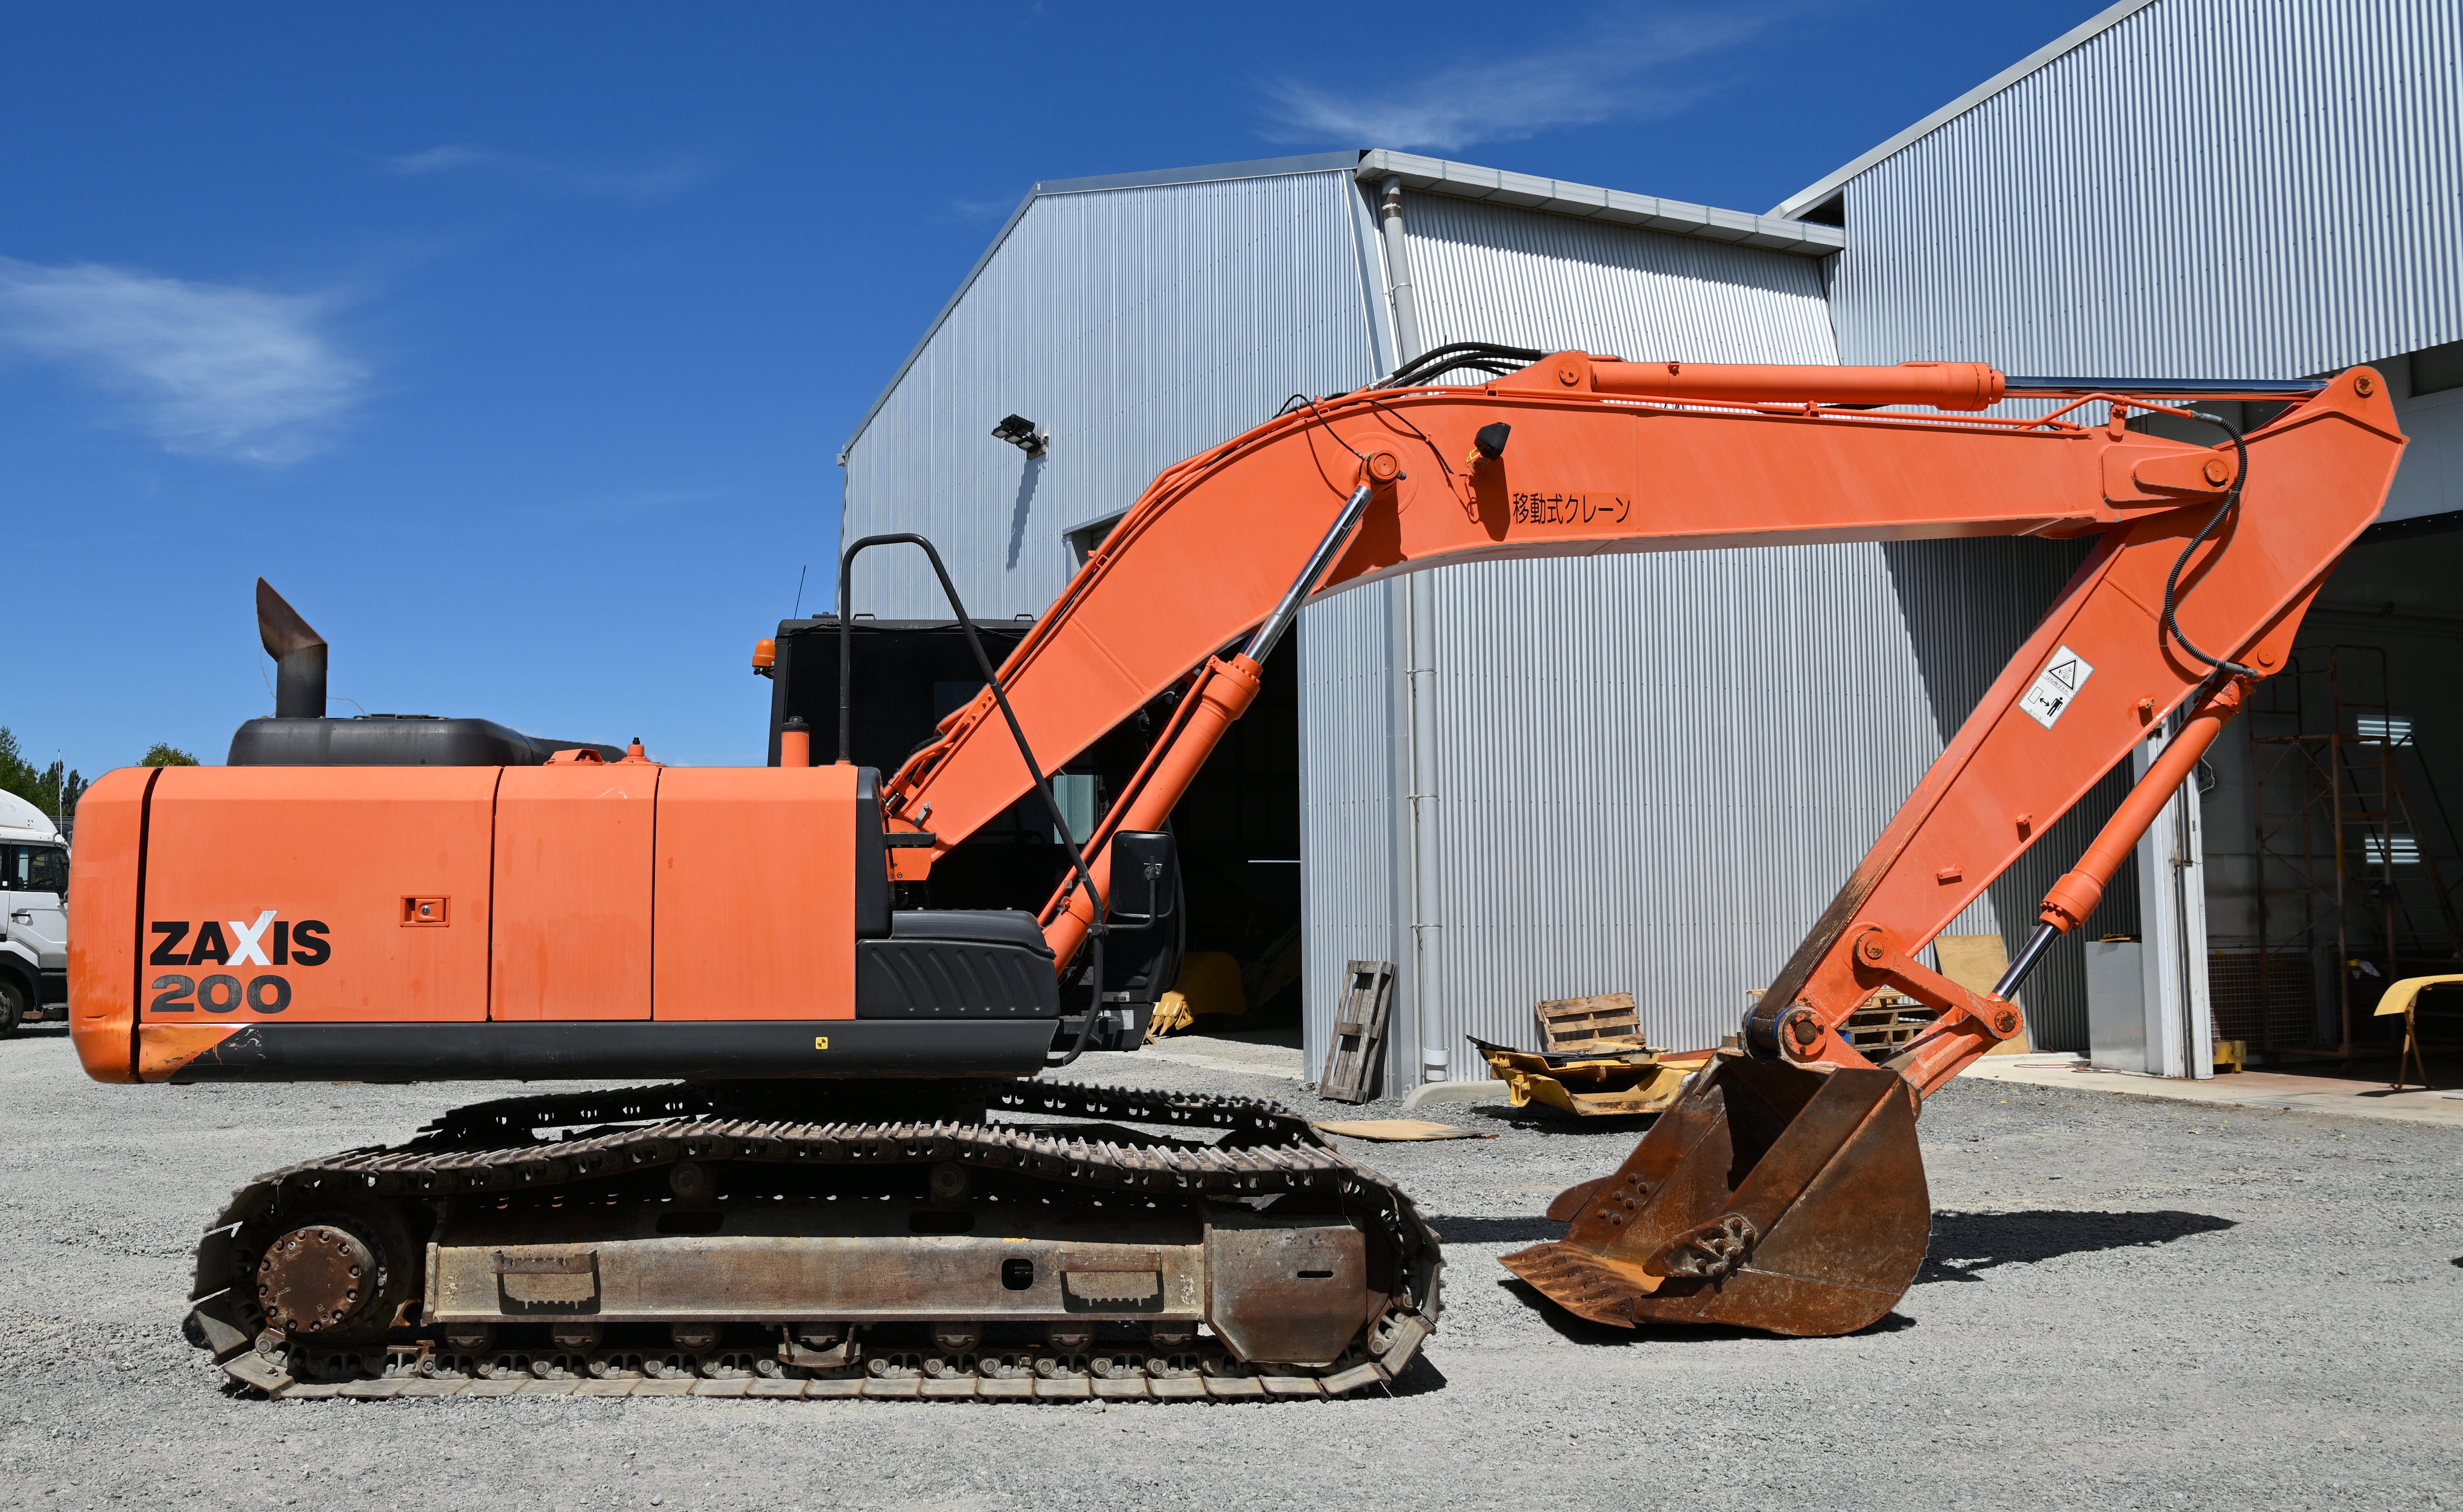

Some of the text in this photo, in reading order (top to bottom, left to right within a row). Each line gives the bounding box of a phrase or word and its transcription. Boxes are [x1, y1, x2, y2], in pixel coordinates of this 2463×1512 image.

[1513, 492, 1630, 524] 移動式クレーン
[150, 910, 331, 966] ZAXIS
[150, 974, 291, 1014] 200
